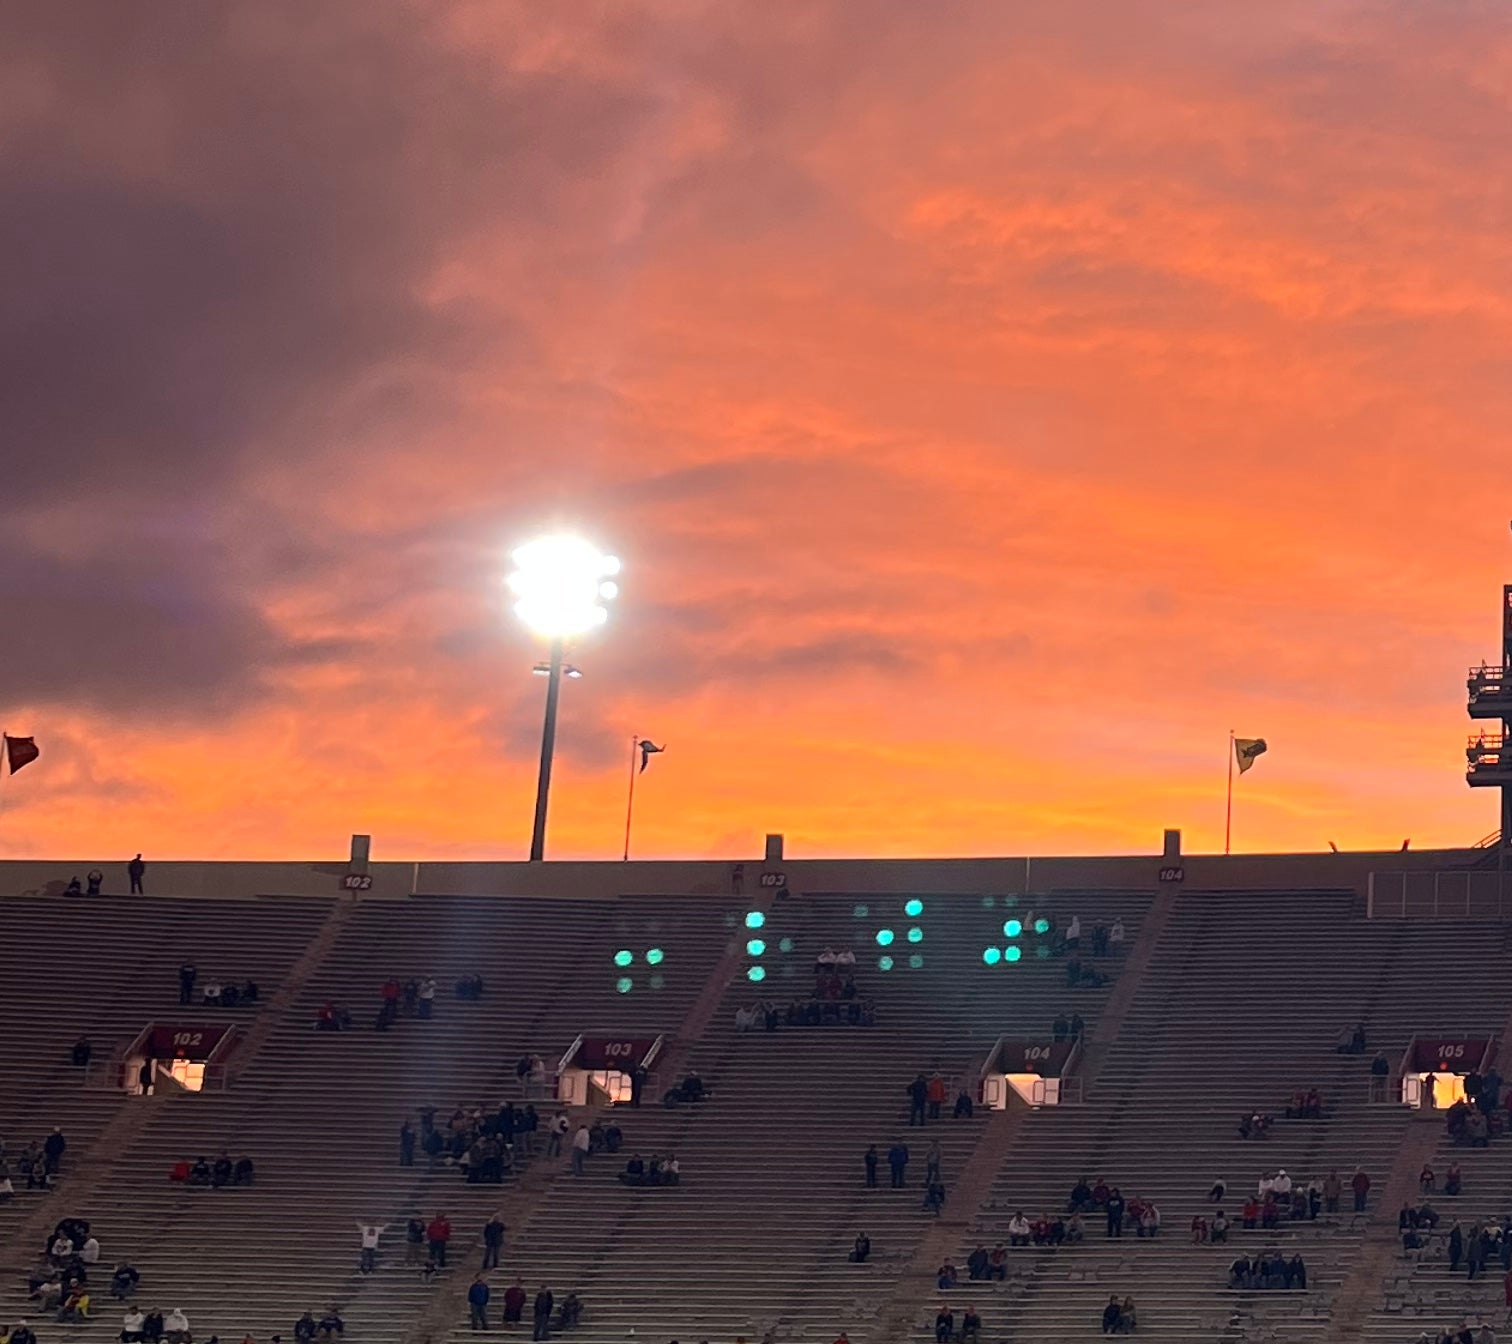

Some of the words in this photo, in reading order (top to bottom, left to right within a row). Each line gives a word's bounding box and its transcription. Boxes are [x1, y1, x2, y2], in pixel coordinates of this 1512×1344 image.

[346, 876, 371, 889] 102
[762, 874, 786, 886] 103
[173, 1032, 203, 1046] 102
[604, 1042, 633, 1056] 103
[1024, 1046, 1050, 1060] 104
[1438, 1044, 1465, 1058] 105
